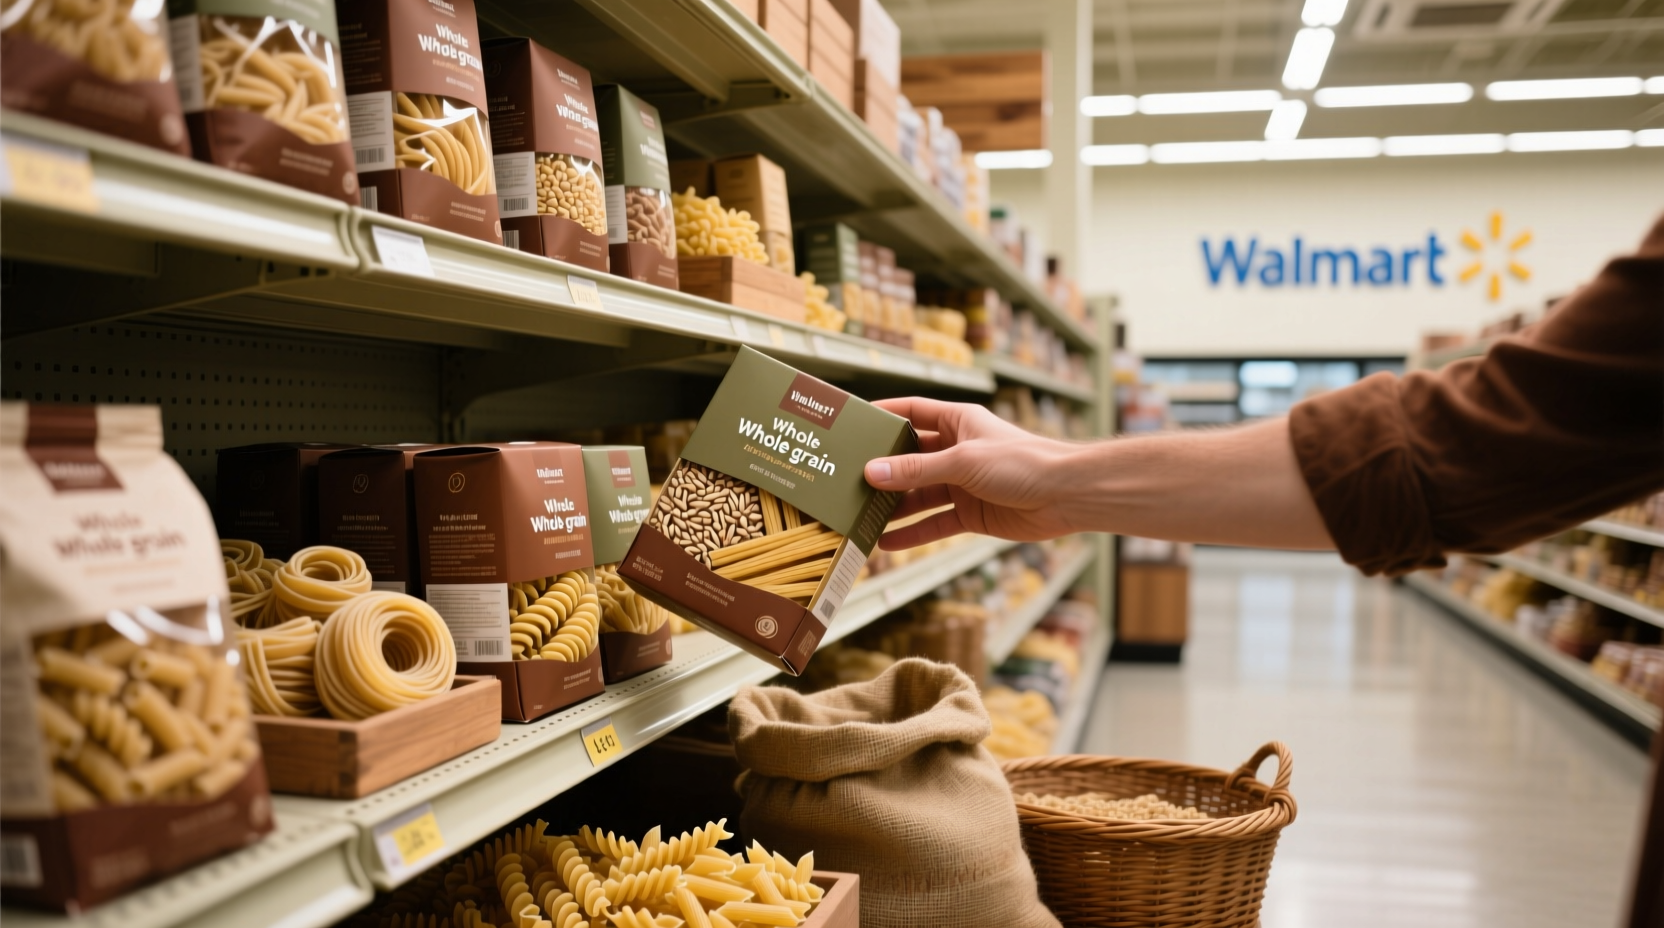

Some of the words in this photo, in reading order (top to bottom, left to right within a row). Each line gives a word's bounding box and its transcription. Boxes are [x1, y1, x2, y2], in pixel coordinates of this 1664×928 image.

[1200, 235, 1446, 285] Walmart
[738, 417, 790, 454] Whole
[788, 447, 836, 477] grain
[773, 417, 821, 449] Whole
